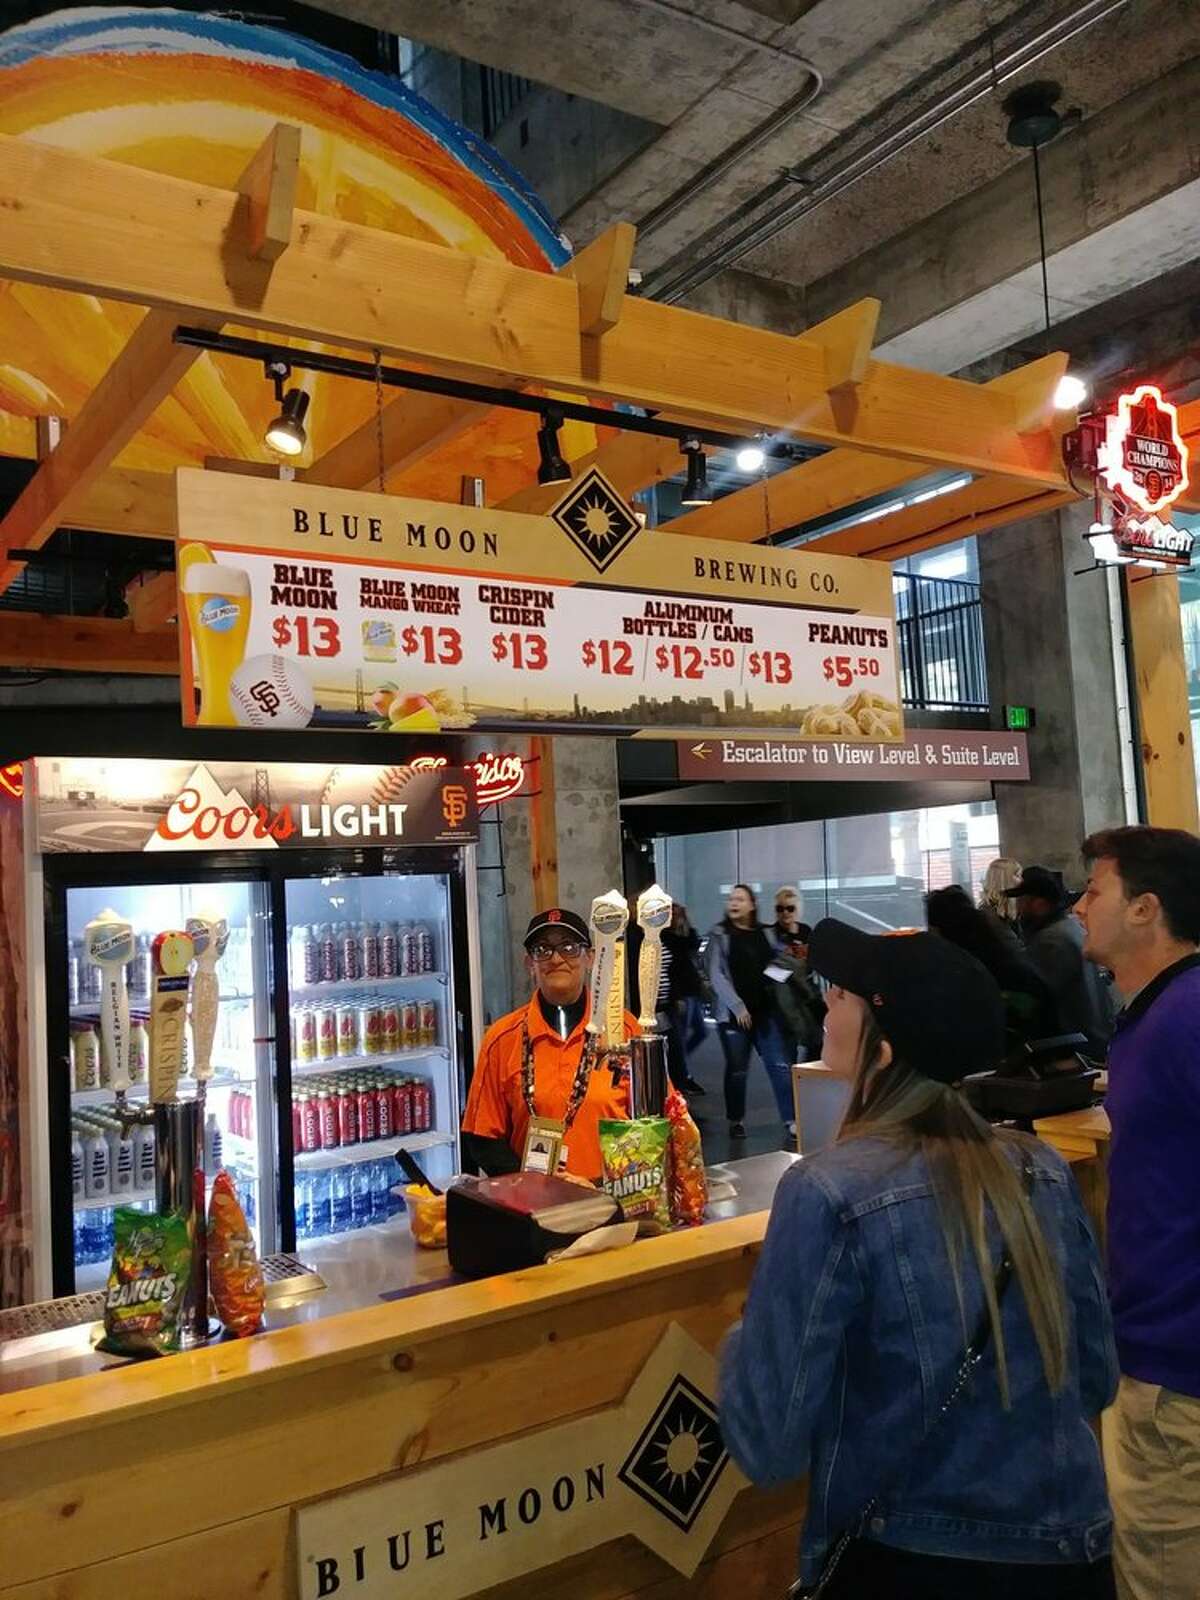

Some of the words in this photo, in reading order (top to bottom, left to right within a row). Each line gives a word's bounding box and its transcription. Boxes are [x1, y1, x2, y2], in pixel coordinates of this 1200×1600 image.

[1128, 450, 1178, 472] CHAMPIONS
[1136, 439, 1169, 456] WORLD
[293, 508, 383, 542] BLUE
[407, 523, 498, 557] MOON
[273, 564, 333, 588] BLUE
[360, 577, 406, 597] BLUE
[411, 583, 460, 602] MOON
[694, 557, 797, 589] BREWING
[811, 573, 840, 594] CO.
[270, 586, 338, 611] MOON
[360, 595, 409, 611] MANGO
[413, 600, 461, 616] WHEAT
[478, 584, 554, 609] CRISPIN
[490, 606, 546, 628] CIDER
[644, 601, 733, 625] ALUMINUM
[272, 615, 342, 658] $13
[402, 624, 463, 665] $13
[622, 617, 697, 639] BOTTLES
[713, 625, 754, 644] CANS
[808, 622, 888, 648] PEANUTS
[492, 632, 548, 670] $13
[582, 639, 634, 676] $12
[656, 644, 735, 680] $12.50
[749, 651, 793, 684] $13
[822, 656, 880, 687] $5.50
[723, 740, 807, 764] Escalator
[812, 744, 829, 764] to
[833, 743, 874, 765] View
[879, 744, 920, 765] Level
[925, 748, 938, 764] &
[942, 746, 979, 766] Suite
[983, 746, 1019, 766] Level
[157, 788, 296, 840] Coors
[301, 804, 408, 837] LIGHT
[159, 1017, 178, 1098] CRISPIN
[479, 1463, 606, 1540] MOON
